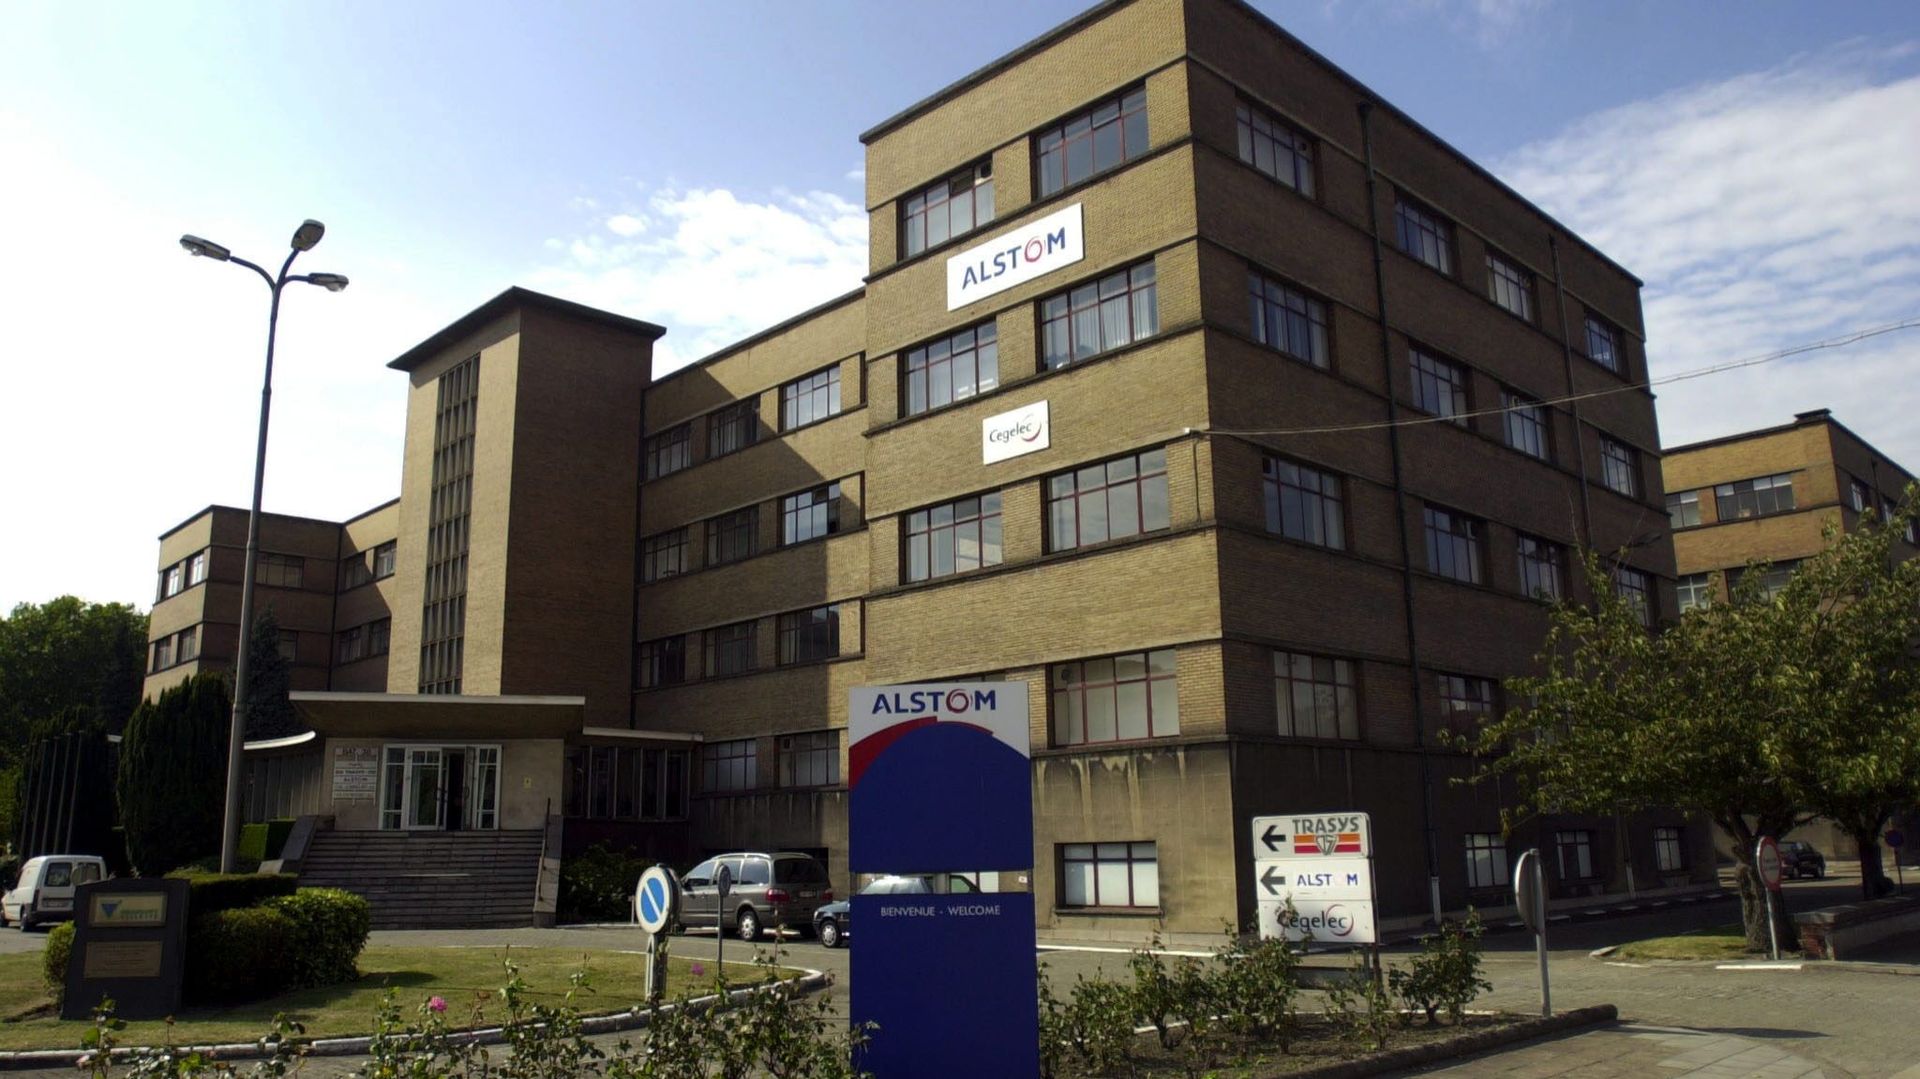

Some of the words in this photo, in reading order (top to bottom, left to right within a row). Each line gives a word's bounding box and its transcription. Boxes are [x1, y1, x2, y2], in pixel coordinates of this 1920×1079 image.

[962, 226, 1066, 290] ALSTOM
[989, 421, 1032, 443] Cegelec
[871, 688, 997, 714] ALSTOM
[1291, 816, 1360, 834] TRASYS
[1296, 873, 1359, 887] ALSTM
[880, 905, 936, 917] BIENVENUE
[947, 904, 1001, 916] WELCOME
